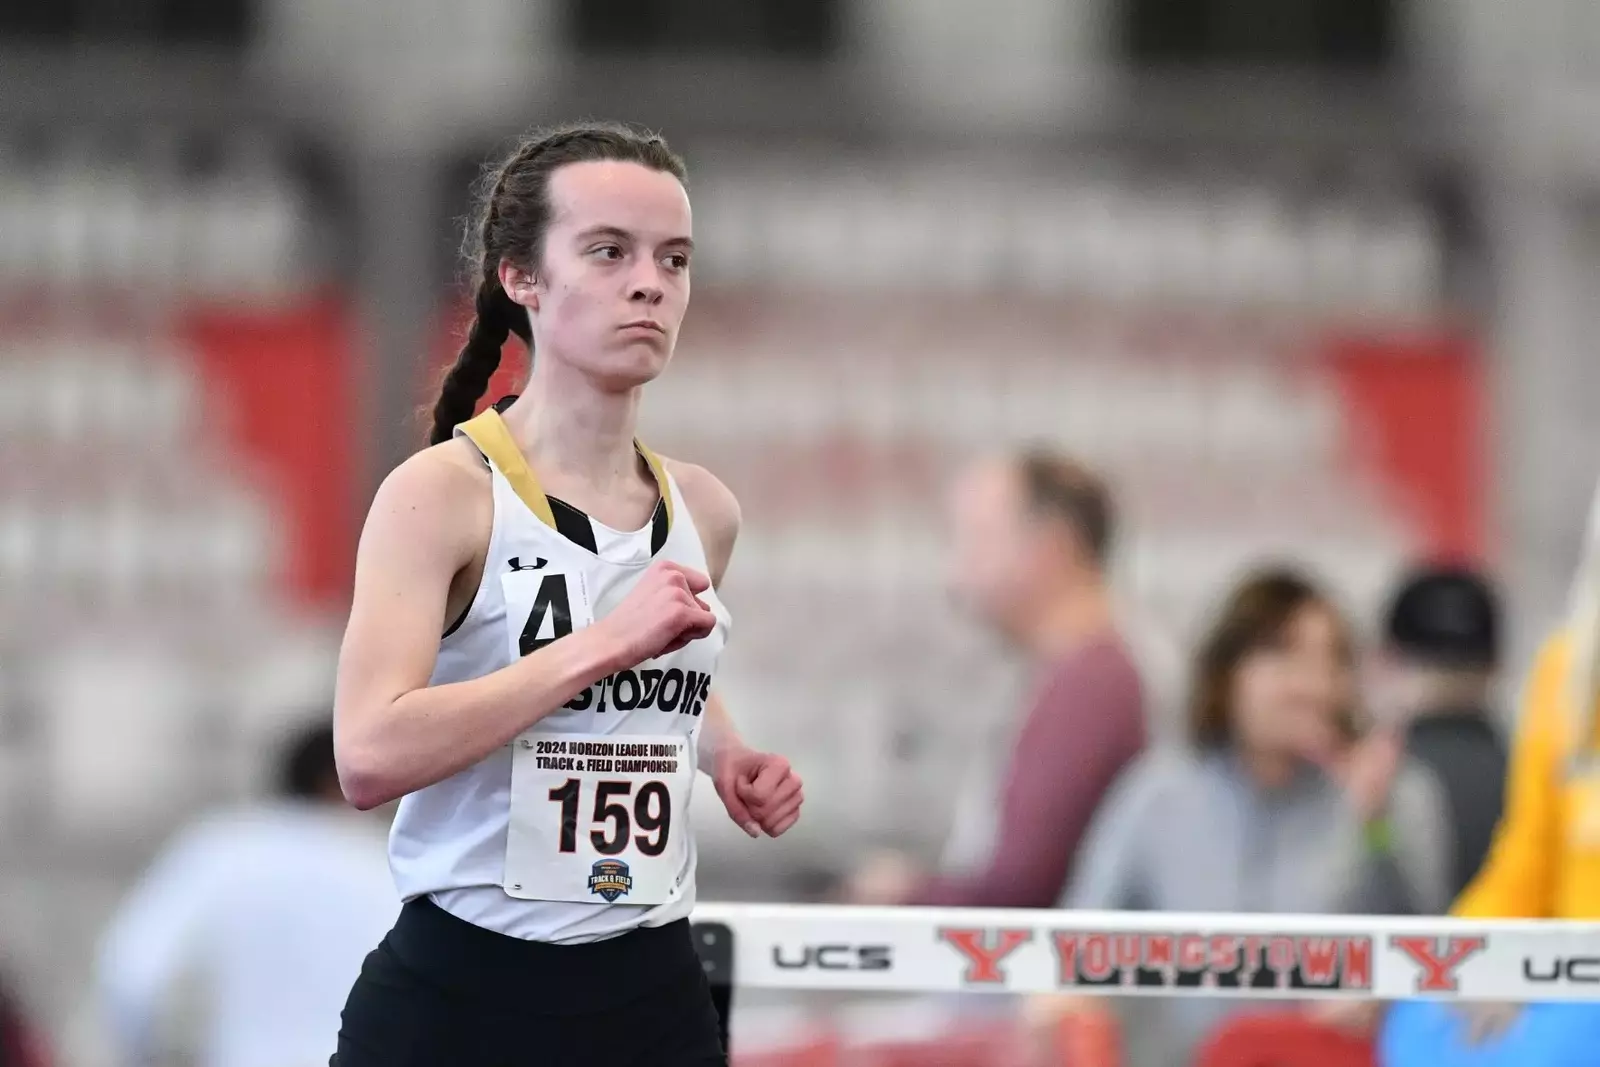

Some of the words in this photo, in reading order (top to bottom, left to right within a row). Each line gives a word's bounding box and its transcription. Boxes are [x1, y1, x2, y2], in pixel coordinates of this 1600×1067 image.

[562, 668, 711, 716] STODONS
[536, 741, 567, 754] 2024
[569, 742, 614, 757] HORIZON
[615, 744, 648, 757] LEAGUE
[650, 744, 677, 758] INDOOR
[536, 757, 574, 771] TRACK
[576, 761, 585, 771] &
[587, 759, 613, 773] FIELD
[615, 760, 678, 774] CHAMPIONSHIP
[548, 778, 671, 857] 159
[591, 875, 609, 885] TRACK
[616, 876, 631, 886] FIELD
[772, 946, 892, 970] UCS
[937, 927, 1034, 983] Y
[1050, 931, 1372, 988] YOUNGSTOWN
[1389, 935, 1486, 991] Y
[1524, 957, 1600, 983] UC
